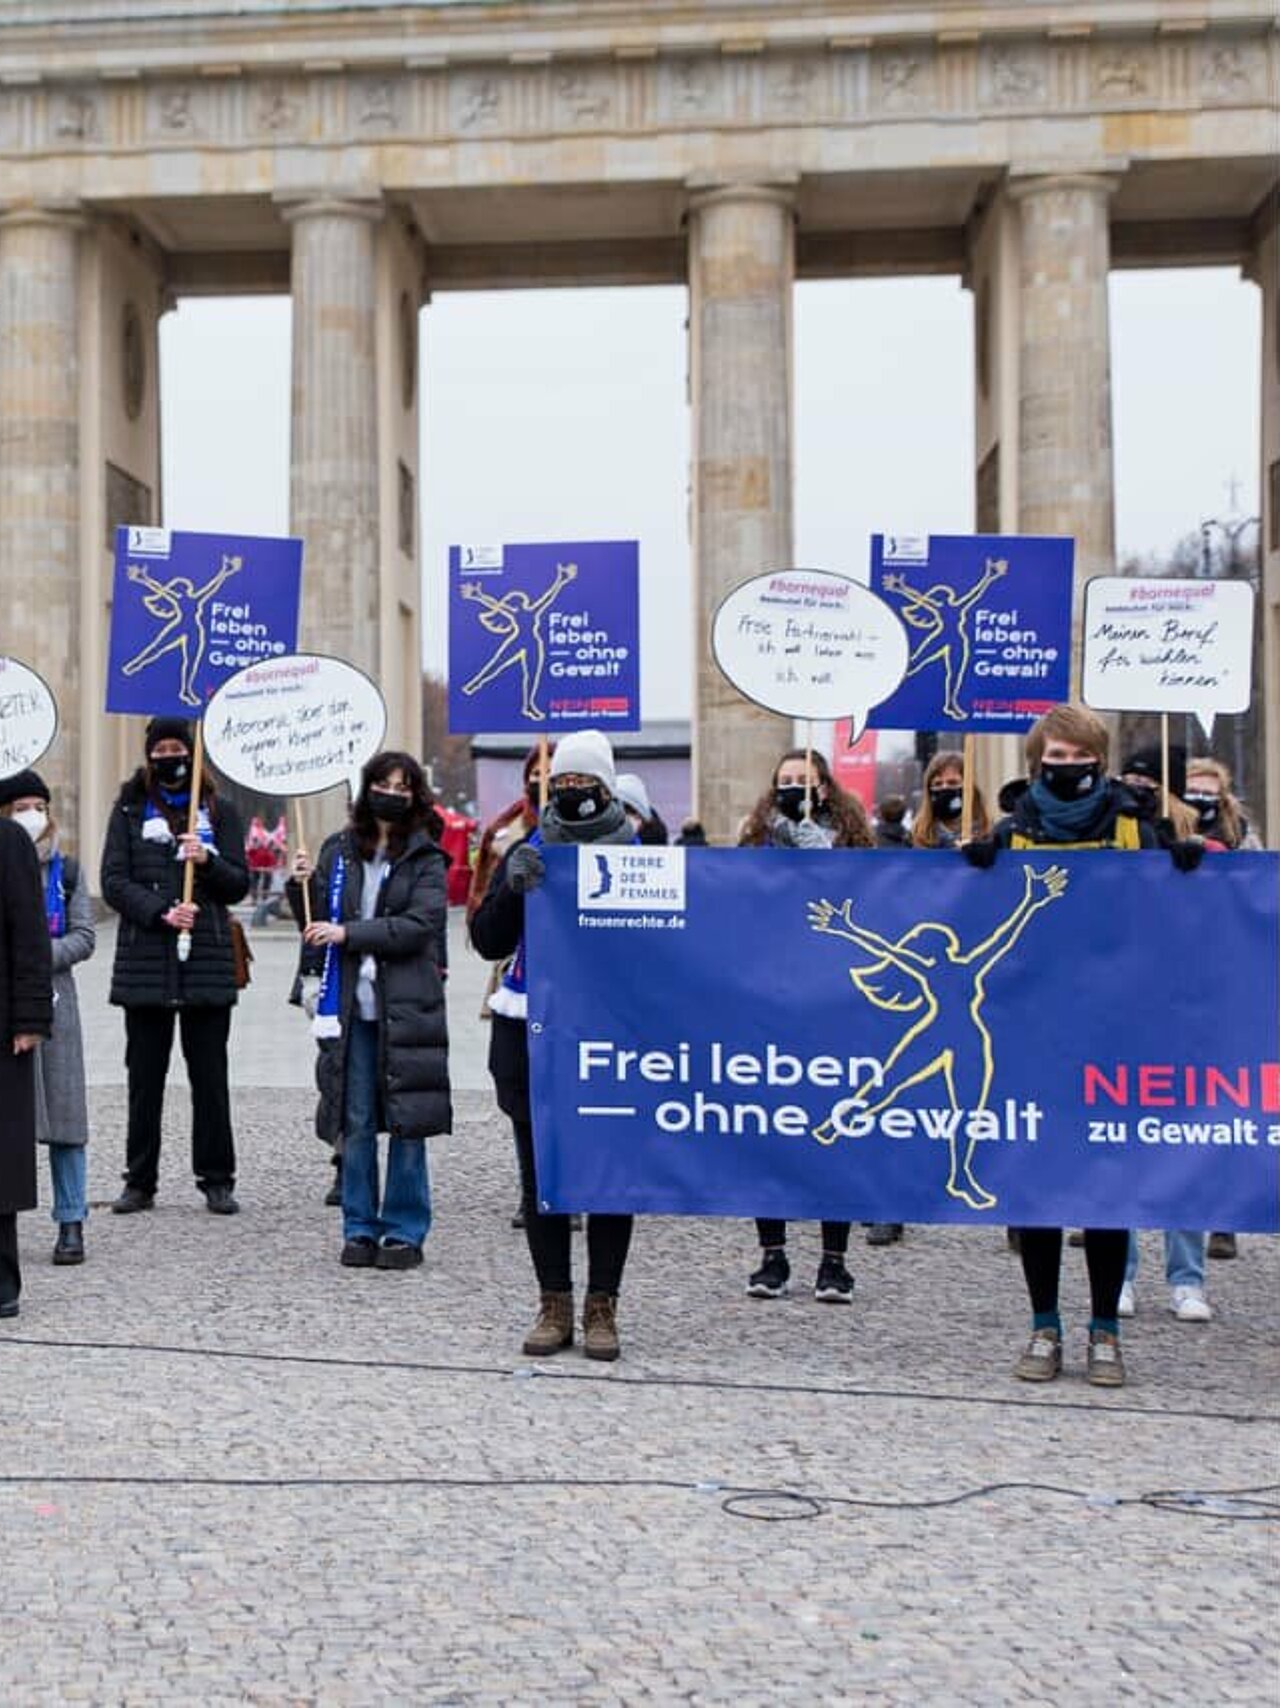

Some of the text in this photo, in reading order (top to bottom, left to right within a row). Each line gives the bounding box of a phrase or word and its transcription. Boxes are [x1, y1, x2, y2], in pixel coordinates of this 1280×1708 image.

[211, 602, 250, 619] Frei
[974, 609, 1018, 626] Frei
[210, 618, 267, 636] leben
[549, 611, 589, 627] Frei
[548, 629, 608, 644] leben
[974, 626, 1037, 643] leben
[235, 638, 286, 654] ohne
[575, 647, 628, 660] ohne
[1002, 646, 1058, 660] ohne
[208, 651, 269, 667] Gew
[549, 661, 620, 676] Gewalt
[973, 660, 1048, 677] Gewalt
[621, 856, 665, 868] TERRE
[621, 872, 646, 883] DES
[620, 888, 678, 899] FEMMES
[578, 913, 686, 929] frauenrechte.de
[577, 1041, 885, 1087] Frei leben
[1084, 1064, 1251, 1108] NEIN
[655, 1091, 809, 1135] ohne
[830, 1098, 1044, 1141] Gewalt
[1088, 1120, 1127, 1142] zu
[1137, 1116, 1258, 1145] Gewalt
